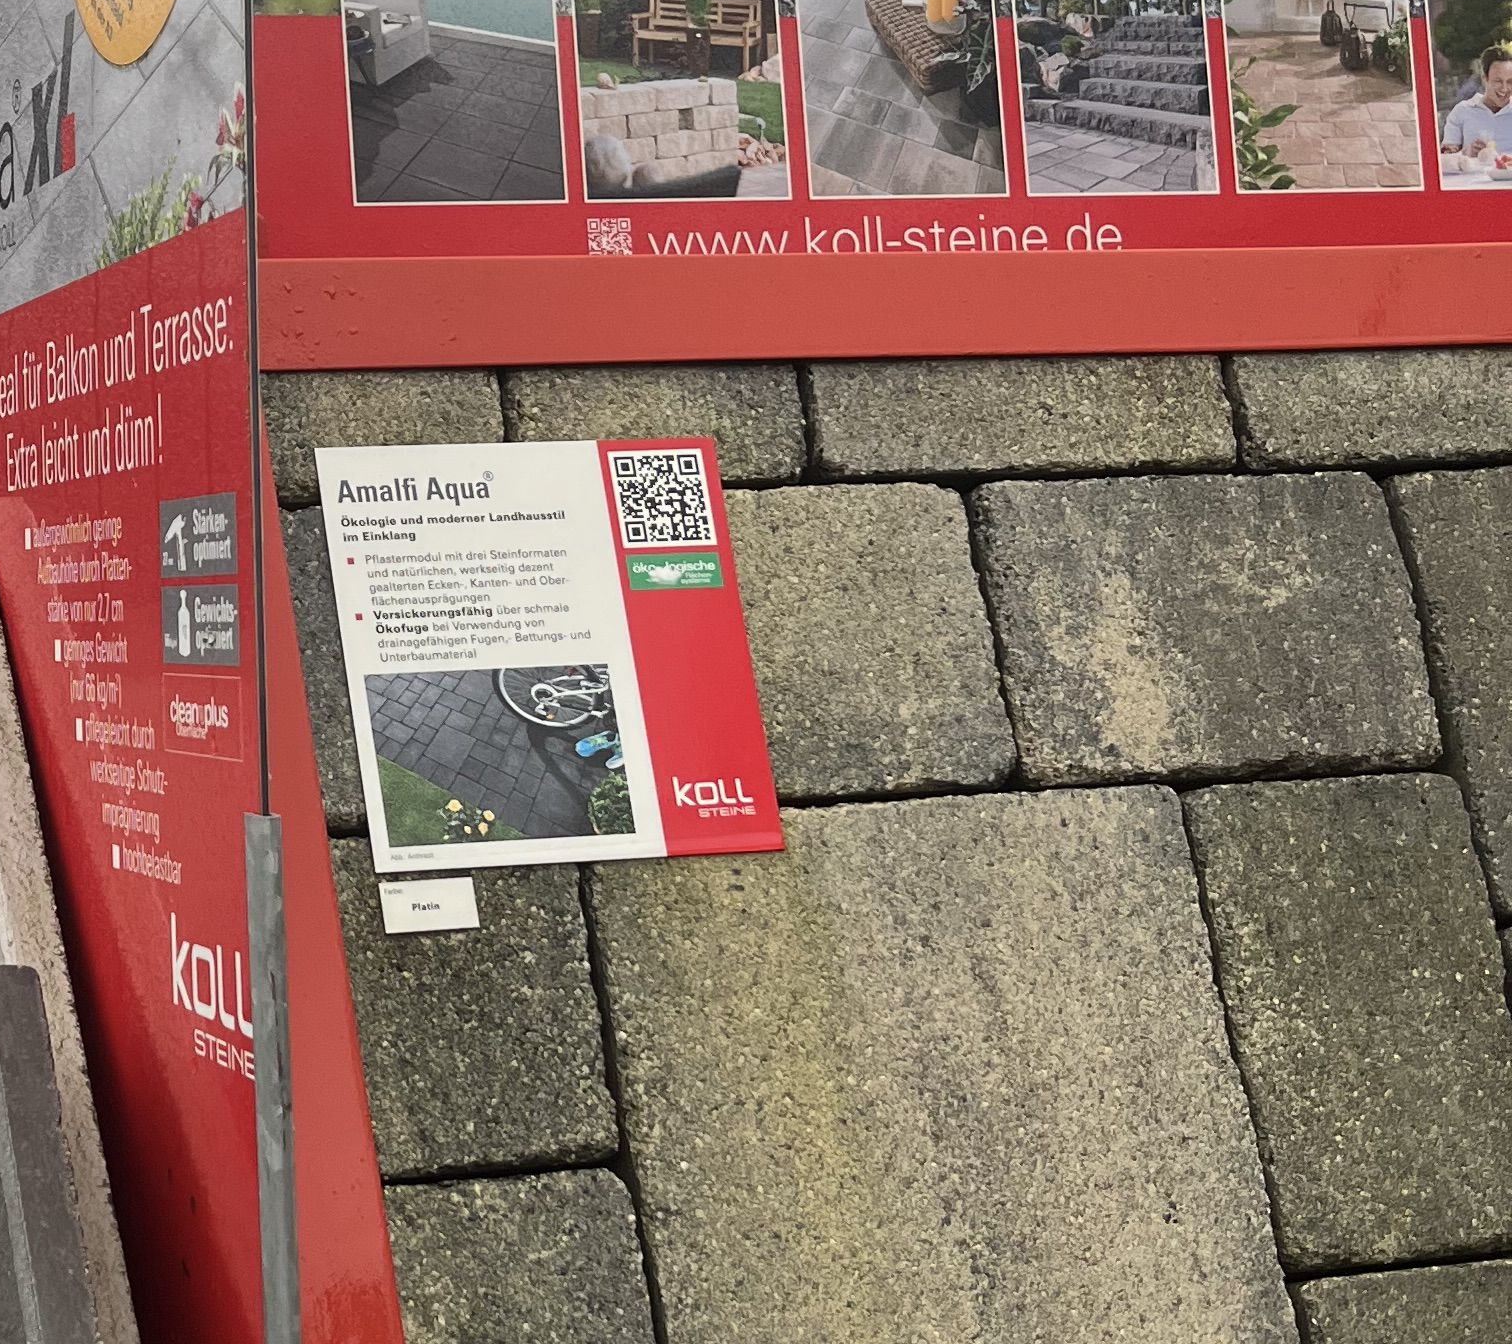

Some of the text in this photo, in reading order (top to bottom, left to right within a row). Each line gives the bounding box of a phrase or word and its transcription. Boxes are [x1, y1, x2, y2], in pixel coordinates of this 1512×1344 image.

[22, 350, 42, 410] für
[46, 333, 98, 404] Balkon
[104, 310, 136, 388] und
[140, 295, 234, 375] Terrasse:
[6, 433, 38, 492] Extra
[41, 417, 81, 486] leicht
[83, 407, 111, 478] und
[337, 477, 418, 504] Amalfi
[93, 511, 123, 549] geringe
[192, 508, 228, 535] Stärken-
[340, 510, 565, 528] Ökologie und moderner Landhausstil
[193, 533, 231, 567] optimiert
[342, 530, 416, 542] im Einklang
[38, 554, 79, 585] Aufbauhöhe
[79, 553, 100, 583] durch
[102, 551, 132, 582] Platten-
[364, 548, 567, 565] Pflastermodul mit drei Steinformaten
[366, 562, 554, 579] und natürlichen, werkseitig dezent
[368, 581, 425, 594] gealterten
[469, 577, 512, 588] Kanten-
[514, 575, 537, 587] und
[538, 574, 569, 586] Ober-
[47, 592, 124, 624] stärke von nur 2,7 cm
[194, 595, 238, 624] Gewichts-
[370, 593, 491, 606] flächenausprägungen
[372, 604, 569, 620] Versickerungsfähig über schmale
[374, 619, 545, 635] Ökofuge bei Verwendung von
[377, 635, 468, 649] drainagefähigen
[514, 631, 567, 643] Bettungs-
[569, 628, 592, 640] und
[63, 633, 94, 668] geringes
[95, 632, 128, 664] Gewicht
[379, 647, 477, 663] Unterbaumaterial
[85, 712, 155, 750] pflegeleicht durch
[90, 754, 168, 795] werkseitige Schutz-
[672, 776, 754, 807] KOLL
[101, 793, 160, 844] imprägnierung
[698, 805, 756, 818] STEINE
[122, 840, 182, 885] hochbelastbar
[411, 902, 440, 912] Platin
[170, 911, 253, 1039] KOLL
[194, 1028, 256, 1080] STEINE
